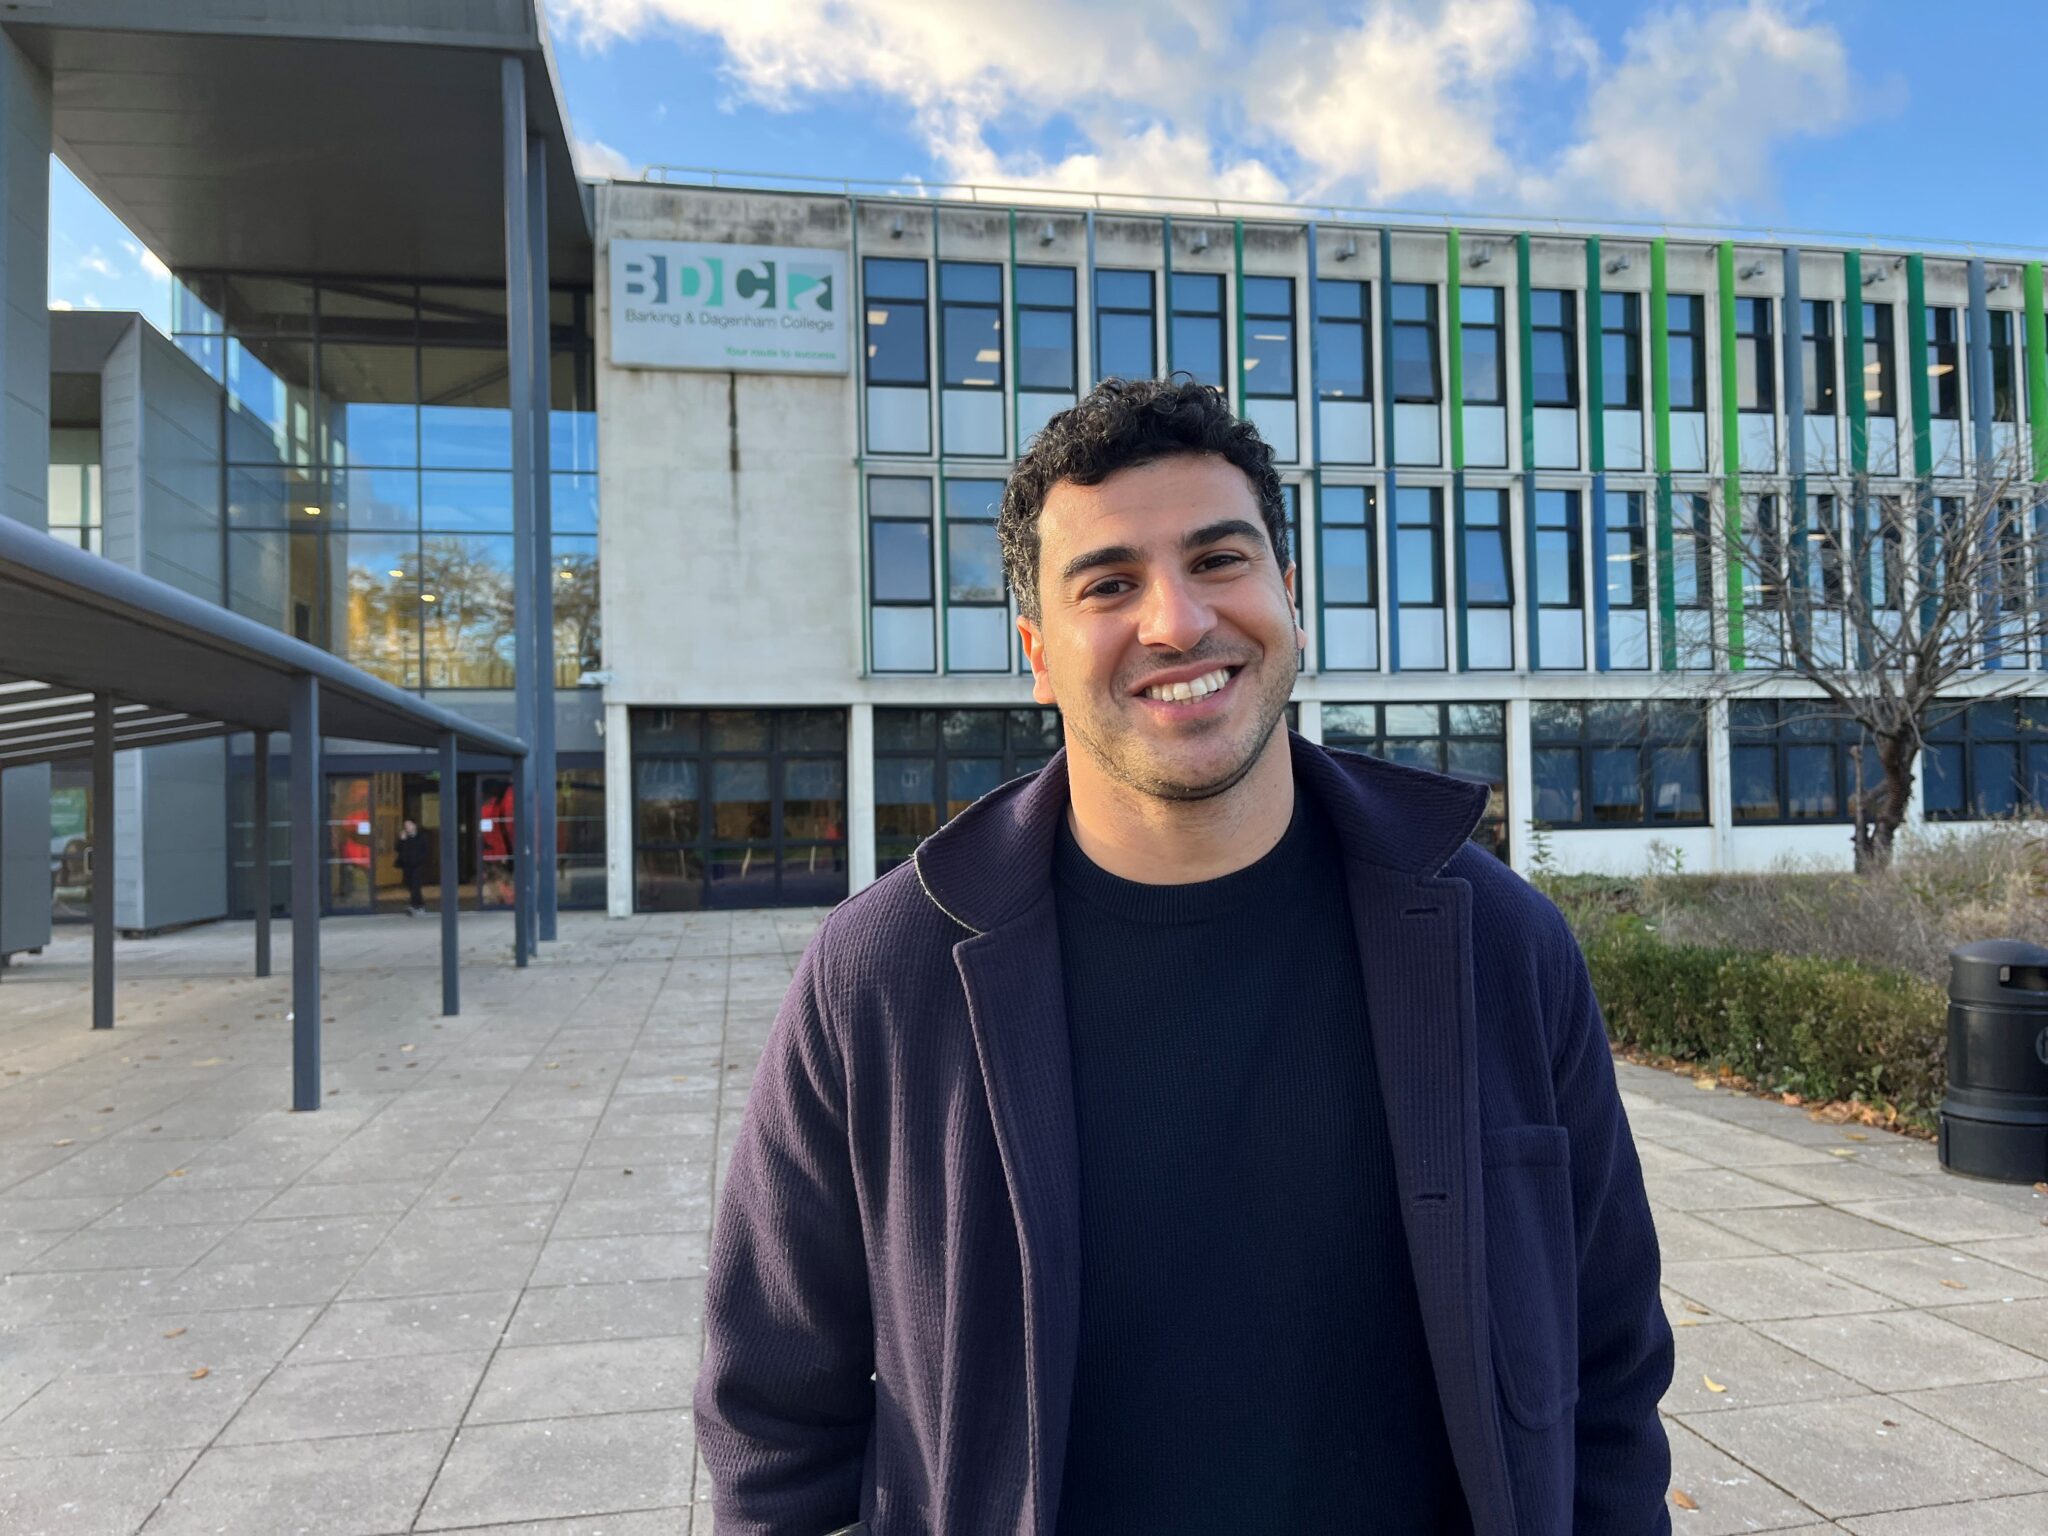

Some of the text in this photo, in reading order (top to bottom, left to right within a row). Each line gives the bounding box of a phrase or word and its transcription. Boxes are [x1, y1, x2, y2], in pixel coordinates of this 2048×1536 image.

[625, 308, 835, 333] Barking & Dagenham College
